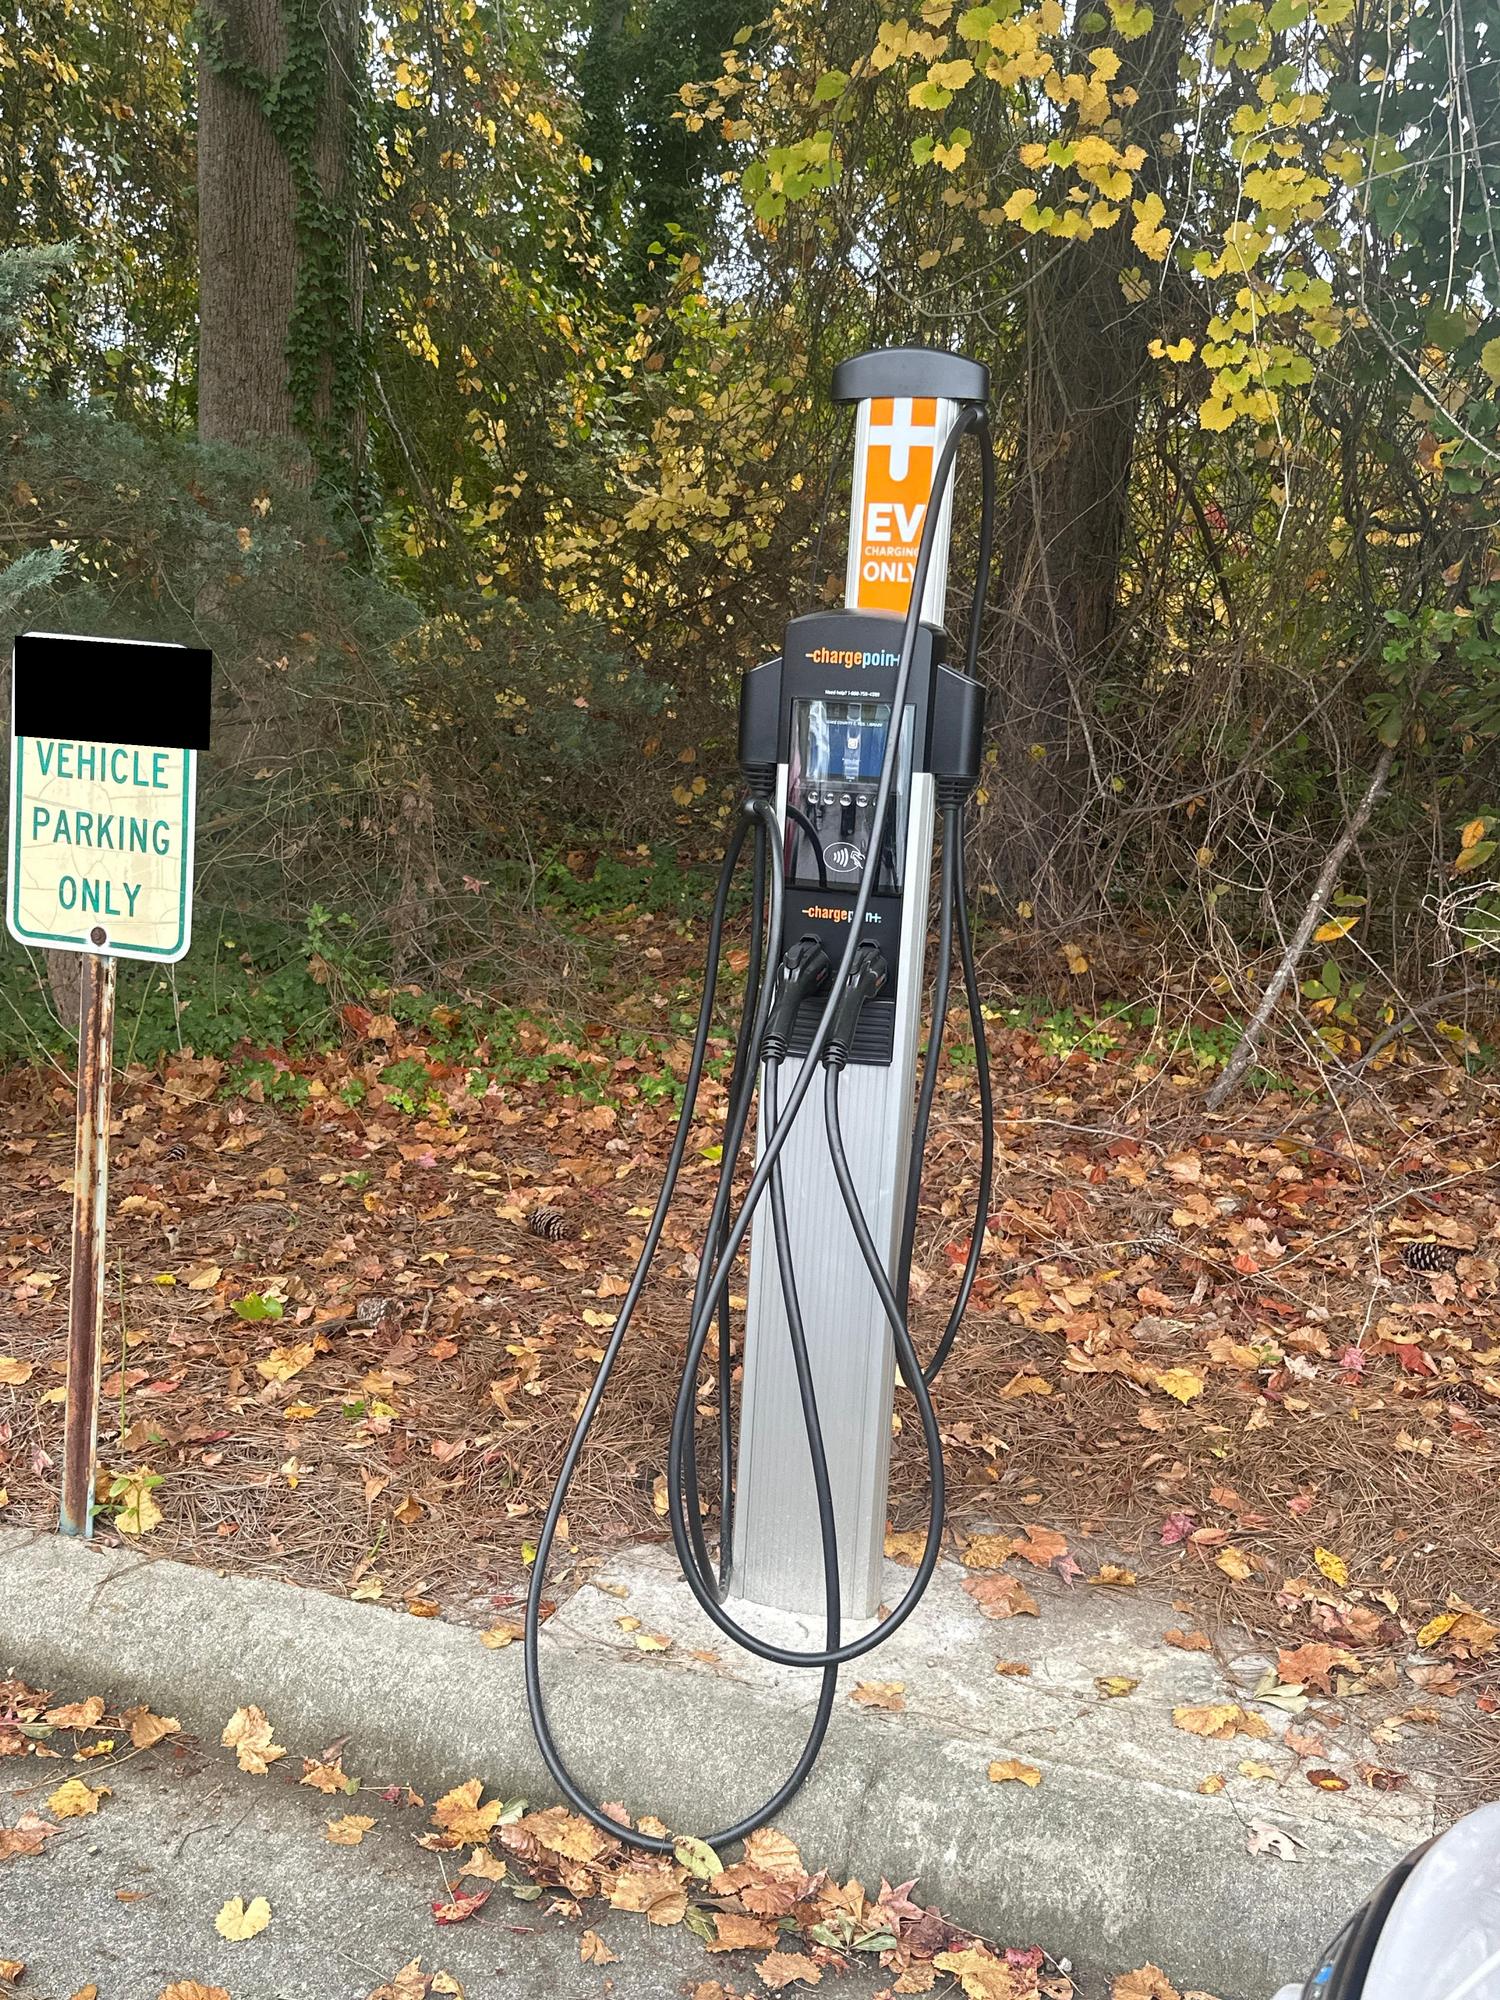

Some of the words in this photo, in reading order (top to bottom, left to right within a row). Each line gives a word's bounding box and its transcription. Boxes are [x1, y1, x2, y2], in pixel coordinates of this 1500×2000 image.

[866, 503, 926, 542] EV
[36, 740, 169, 789] VEHICLE
[33, 807, 170, 855] PARKING
[59, 875, 142, 917] ONLY
[806, 905, 882, 923] chargepnt
